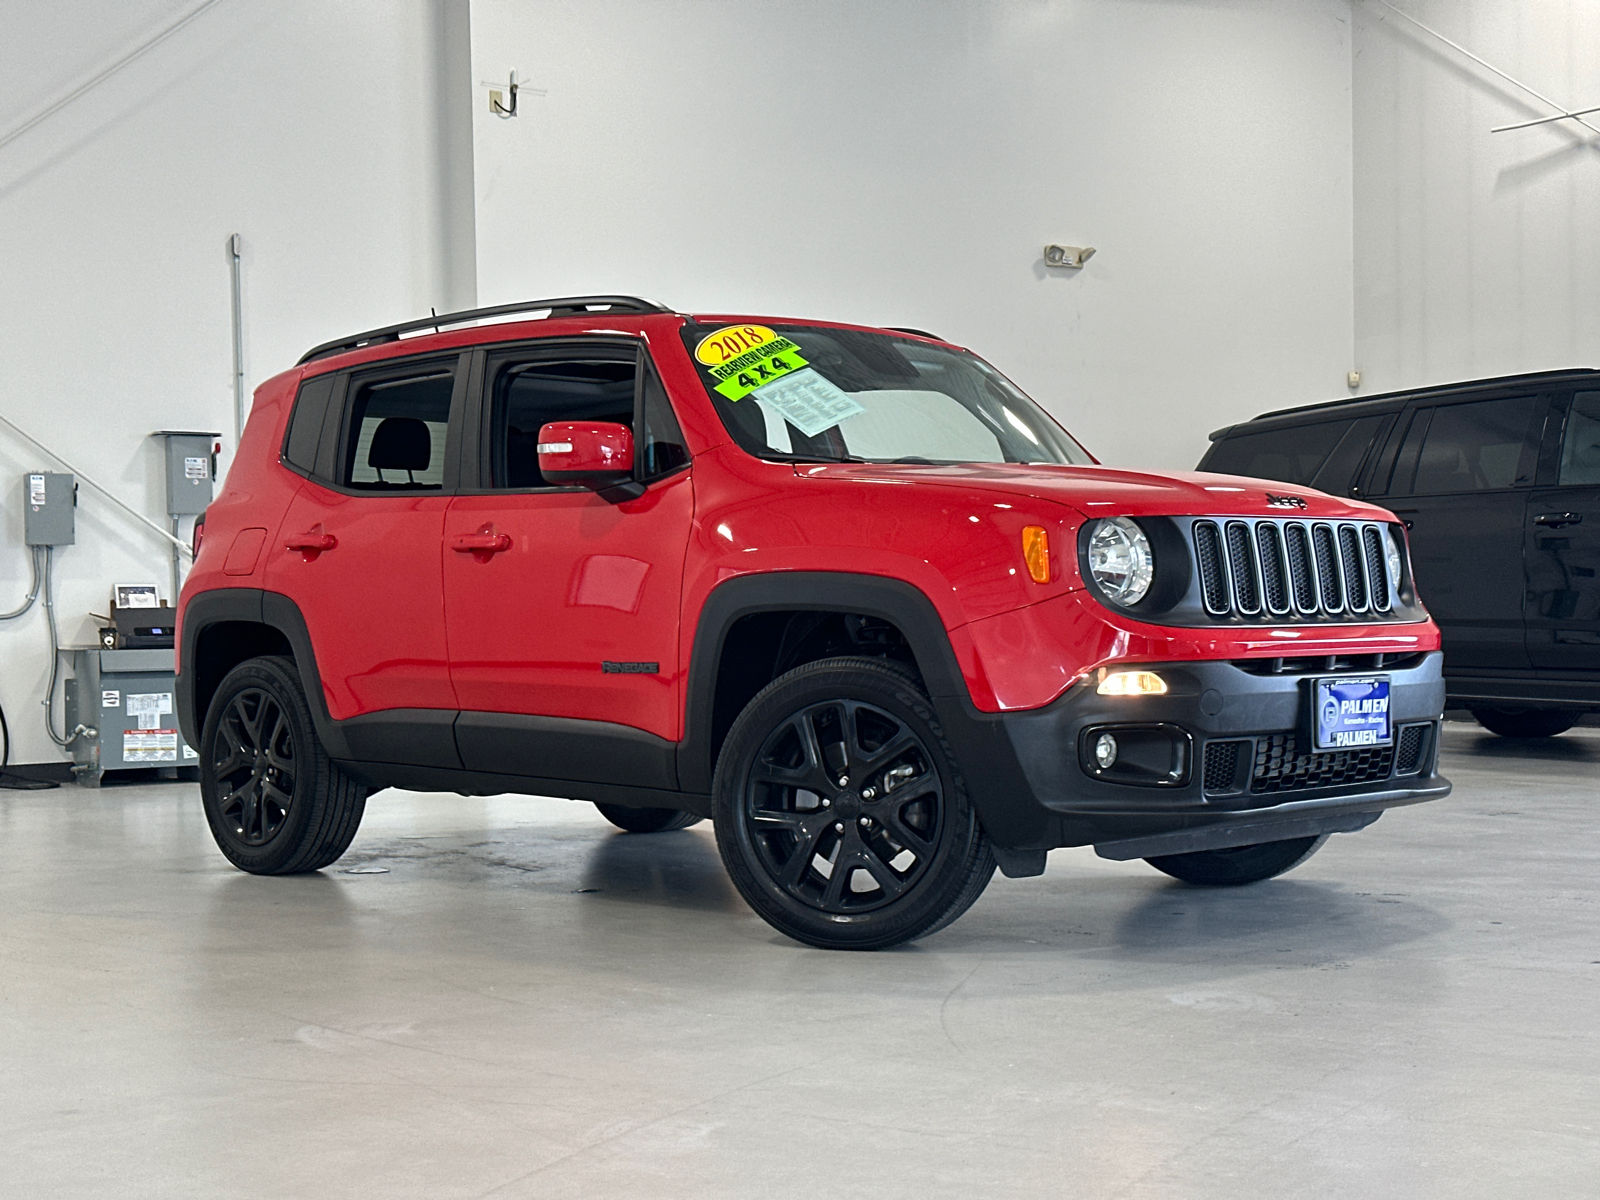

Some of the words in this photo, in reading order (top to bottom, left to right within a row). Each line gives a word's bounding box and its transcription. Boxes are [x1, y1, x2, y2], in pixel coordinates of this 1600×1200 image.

[710, 327, 764, 361] 2018
[713, 350, 763, 380] REARVIEW
[755, 338, 796, 358] CAMERA
[1265, 493, 1308, 511] Jeep
[602, 660, 659, 674] RENEGADE
[1340, 695, 1389, 714] PALMEN
[1336, 730, 1377, 747] PALMEN
